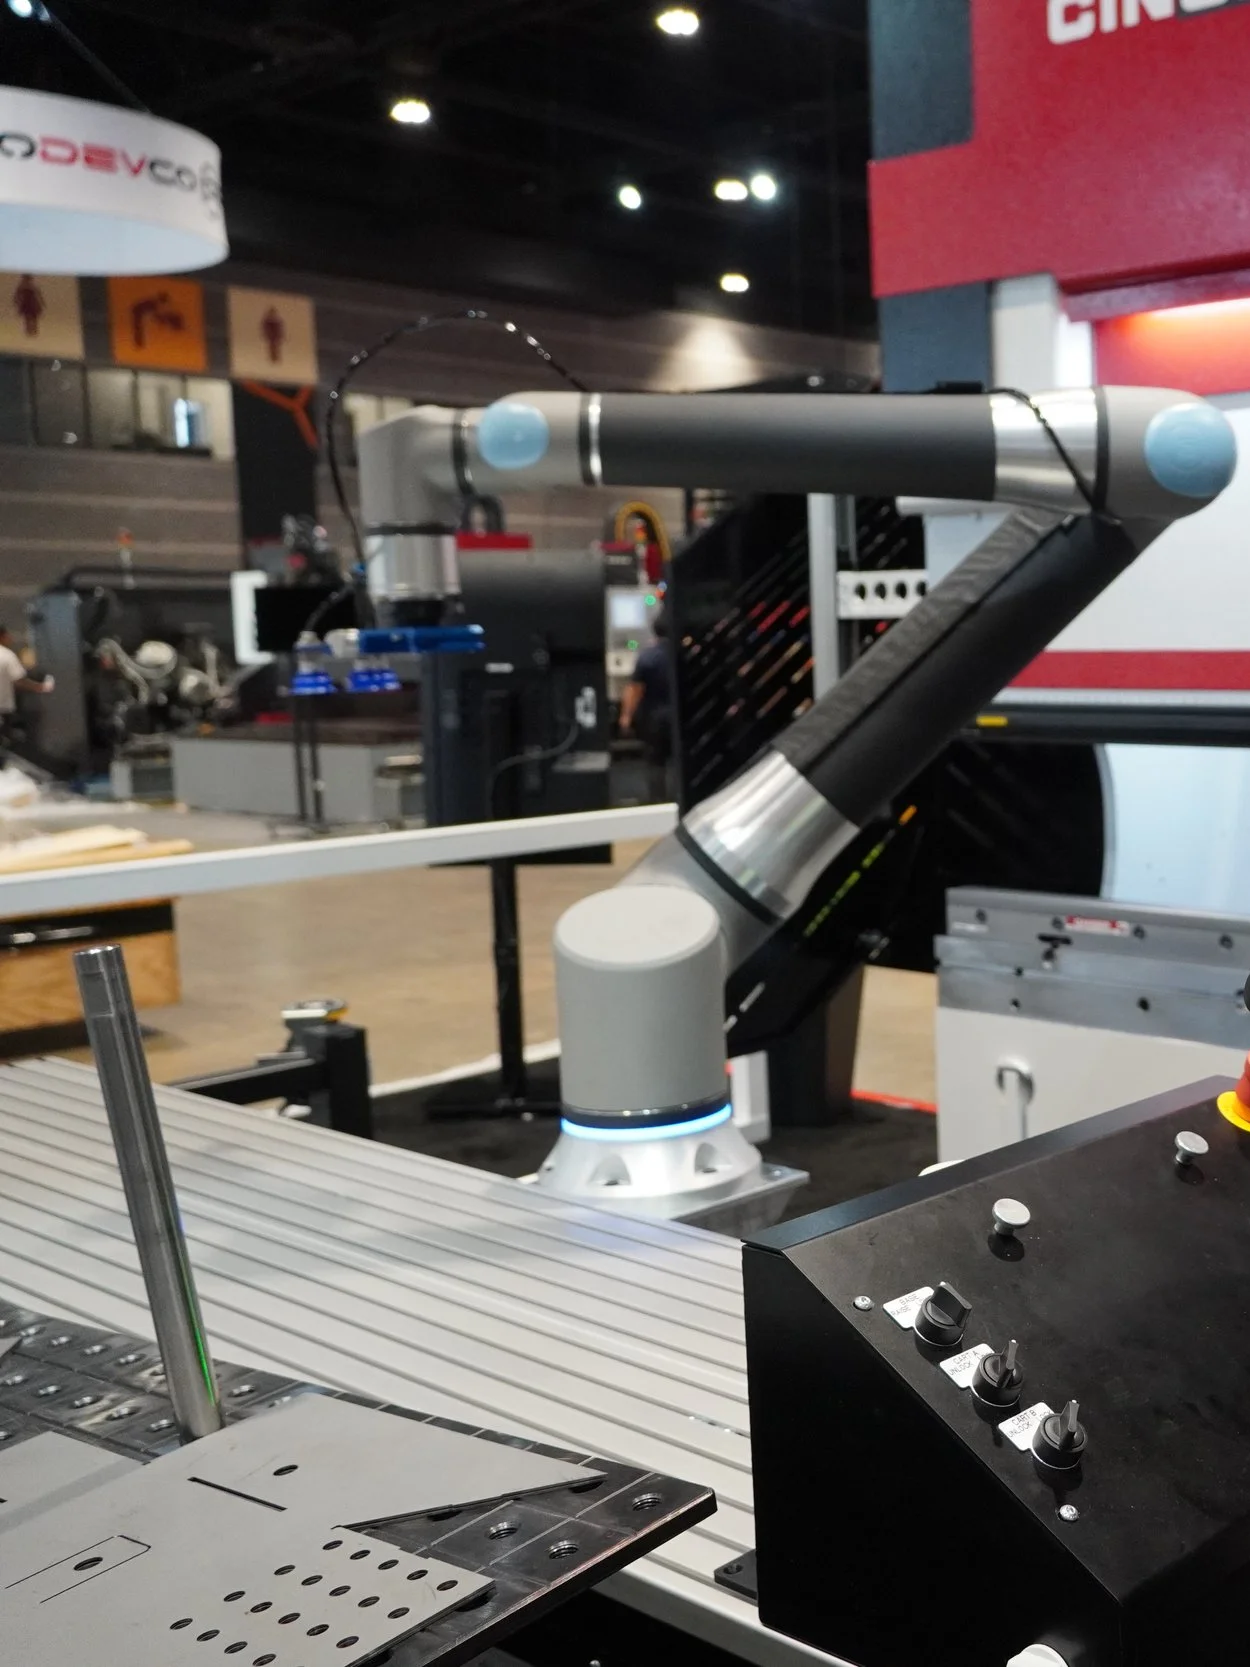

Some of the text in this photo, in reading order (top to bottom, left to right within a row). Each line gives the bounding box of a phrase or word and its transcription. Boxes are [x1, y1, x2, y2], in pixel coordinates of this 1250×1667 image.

[899, 1293, 920, 1306] BASE
[952, 1352, 970, 1365] CART
[947, 1360, 975, 1376] UNLOCK
[1011, 1411, 1031, 1426] CART
[1028, 1409, 1037, 1417] B
[1006, 1420, 1033, 1438] UNLOCK
